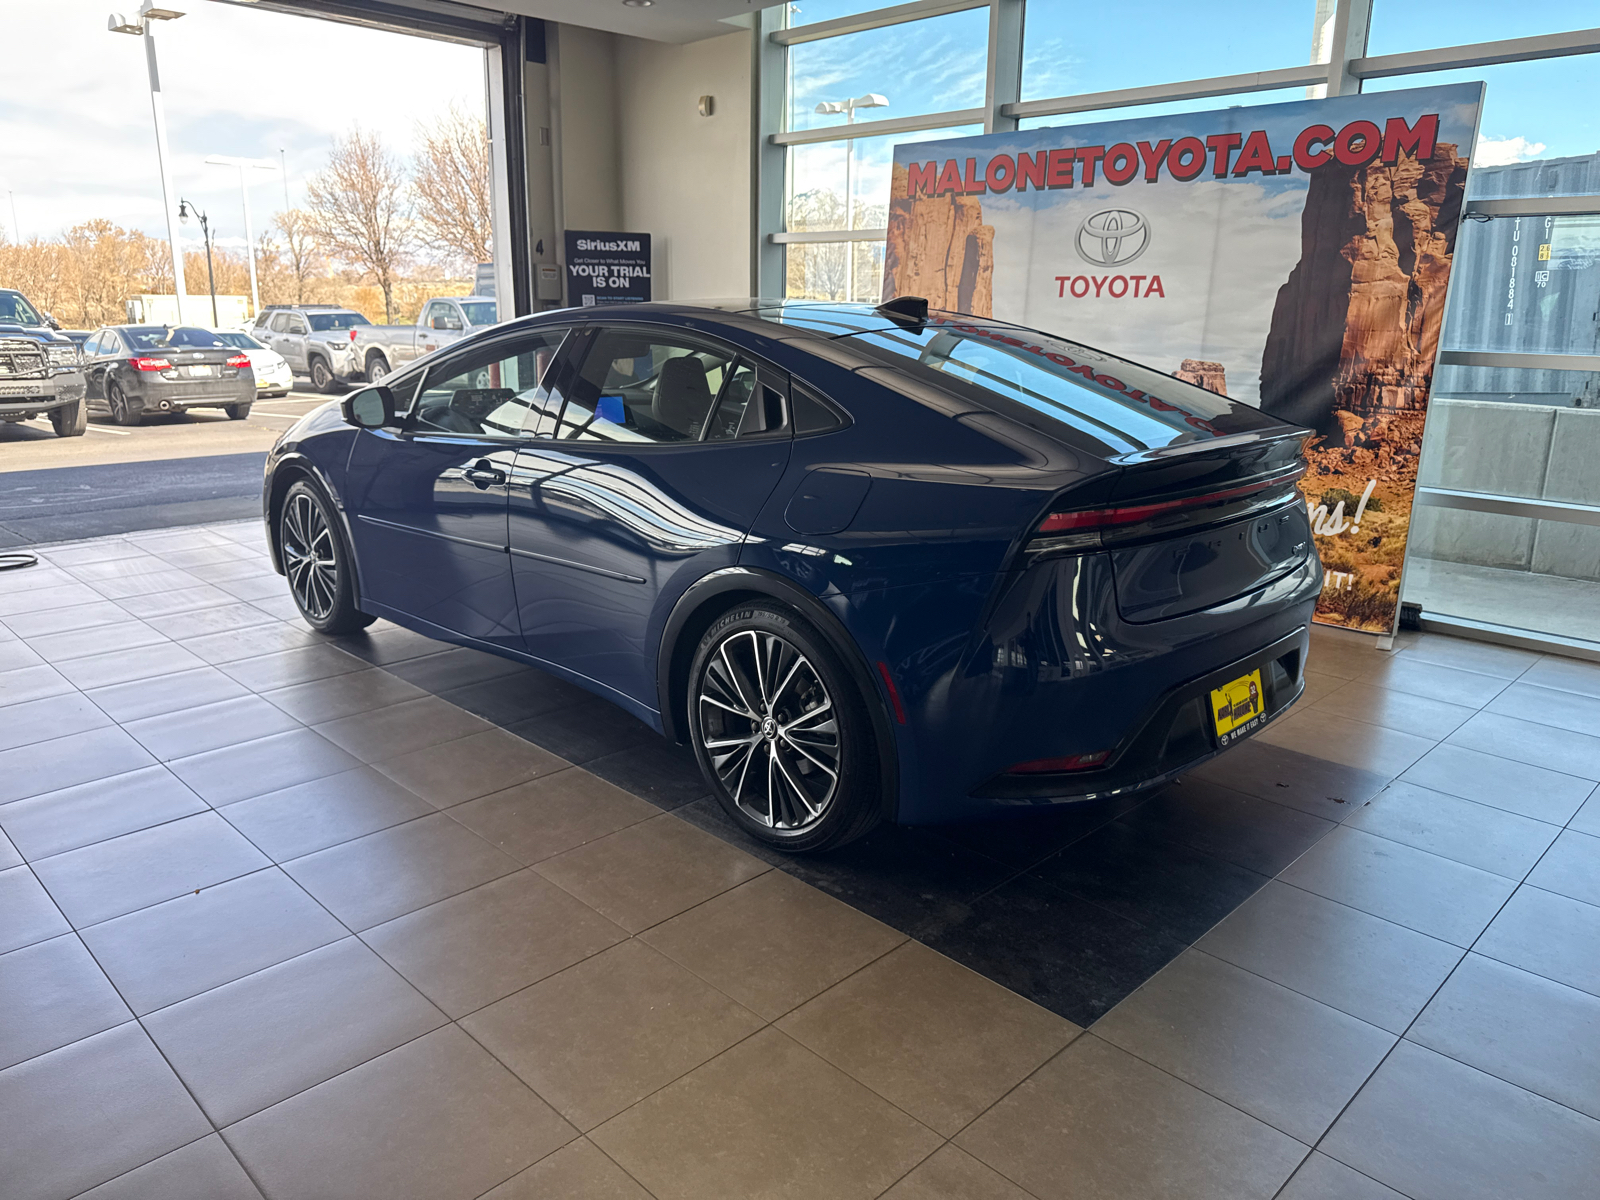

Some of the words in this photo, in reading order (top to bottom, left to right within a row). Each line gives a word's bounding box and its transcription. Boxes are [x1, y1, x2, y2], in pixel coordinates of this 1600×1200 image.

[907, 114, 1441, 199] MALONETOYOTA.COM
[1513, 217, 1521, 241] TU
[1544, 216, 1552, 239] G1
[535, 239, 544, 256] 4
[577, 239, 641, 252] SiriusXM
[569, 265, 609, 276] YOUR
[611, 266, 651, 278] TRIAL
[592, 277, 606, 288] IS
[608, 277, 630, 288] ON
[1507, 245, 1519, 310] 081884
[1055, 275, 1165, 298] TOYOTA
[1324, 570, 1354, 591] IT!
[711, 611, 751, 636] MICHELIN
